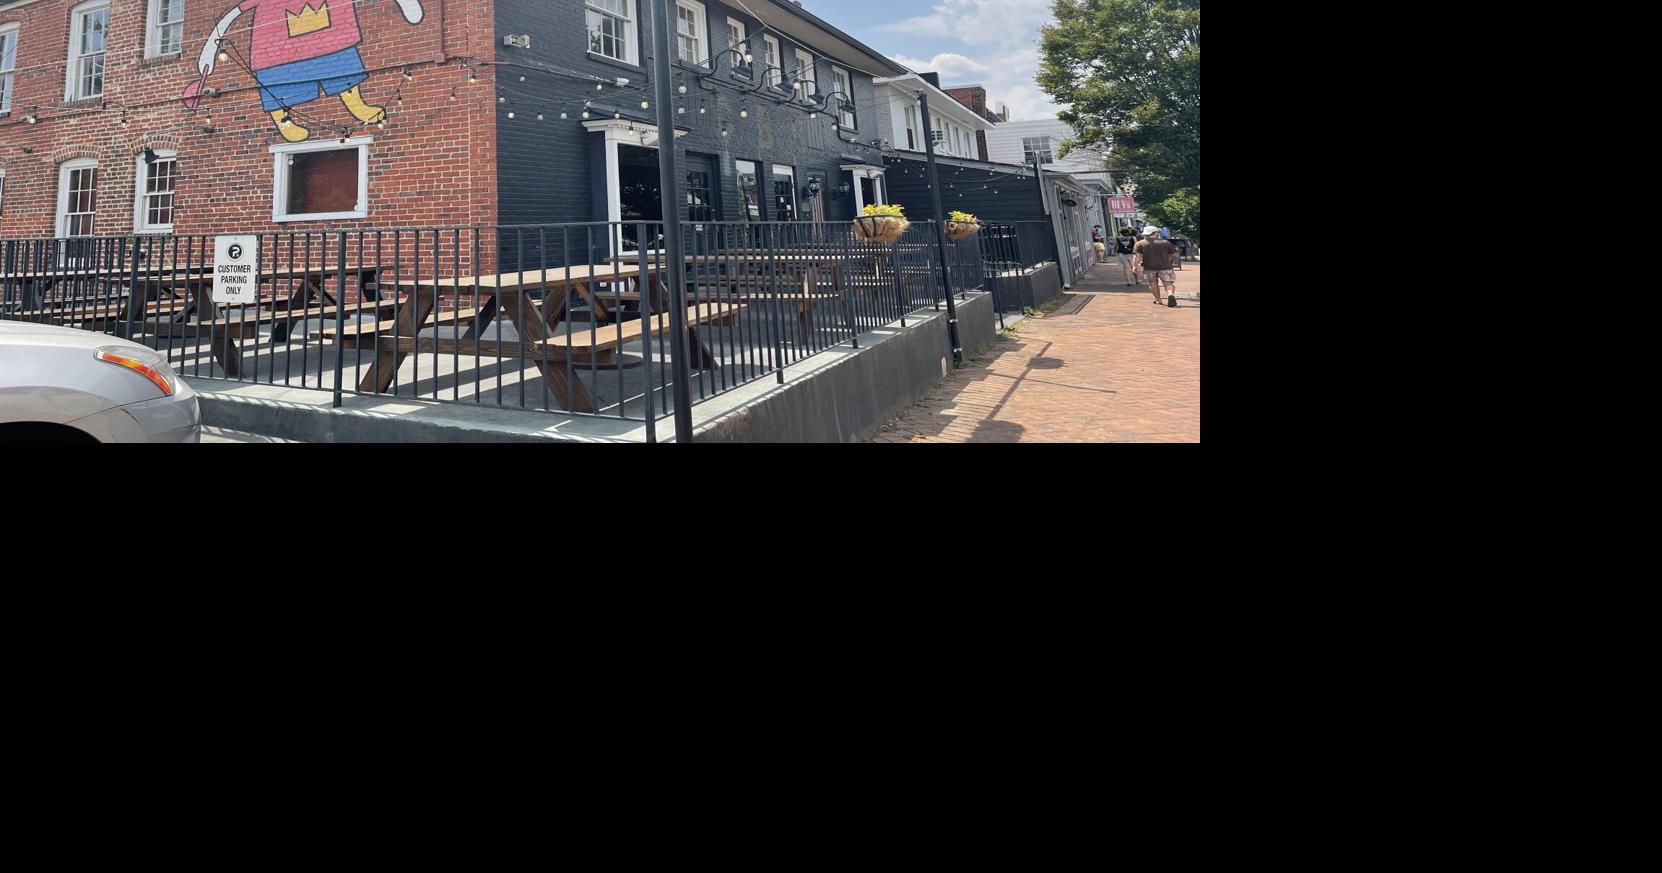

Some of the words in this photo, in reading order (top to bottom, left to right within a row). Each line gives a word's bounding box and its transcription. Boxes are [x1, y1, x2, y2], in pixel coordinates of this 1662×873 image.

[218, 264, 251, 273] CUSTOMER
[221, 275, 247, 284] PARKING
[226, 286, 242, 295] ONLY
